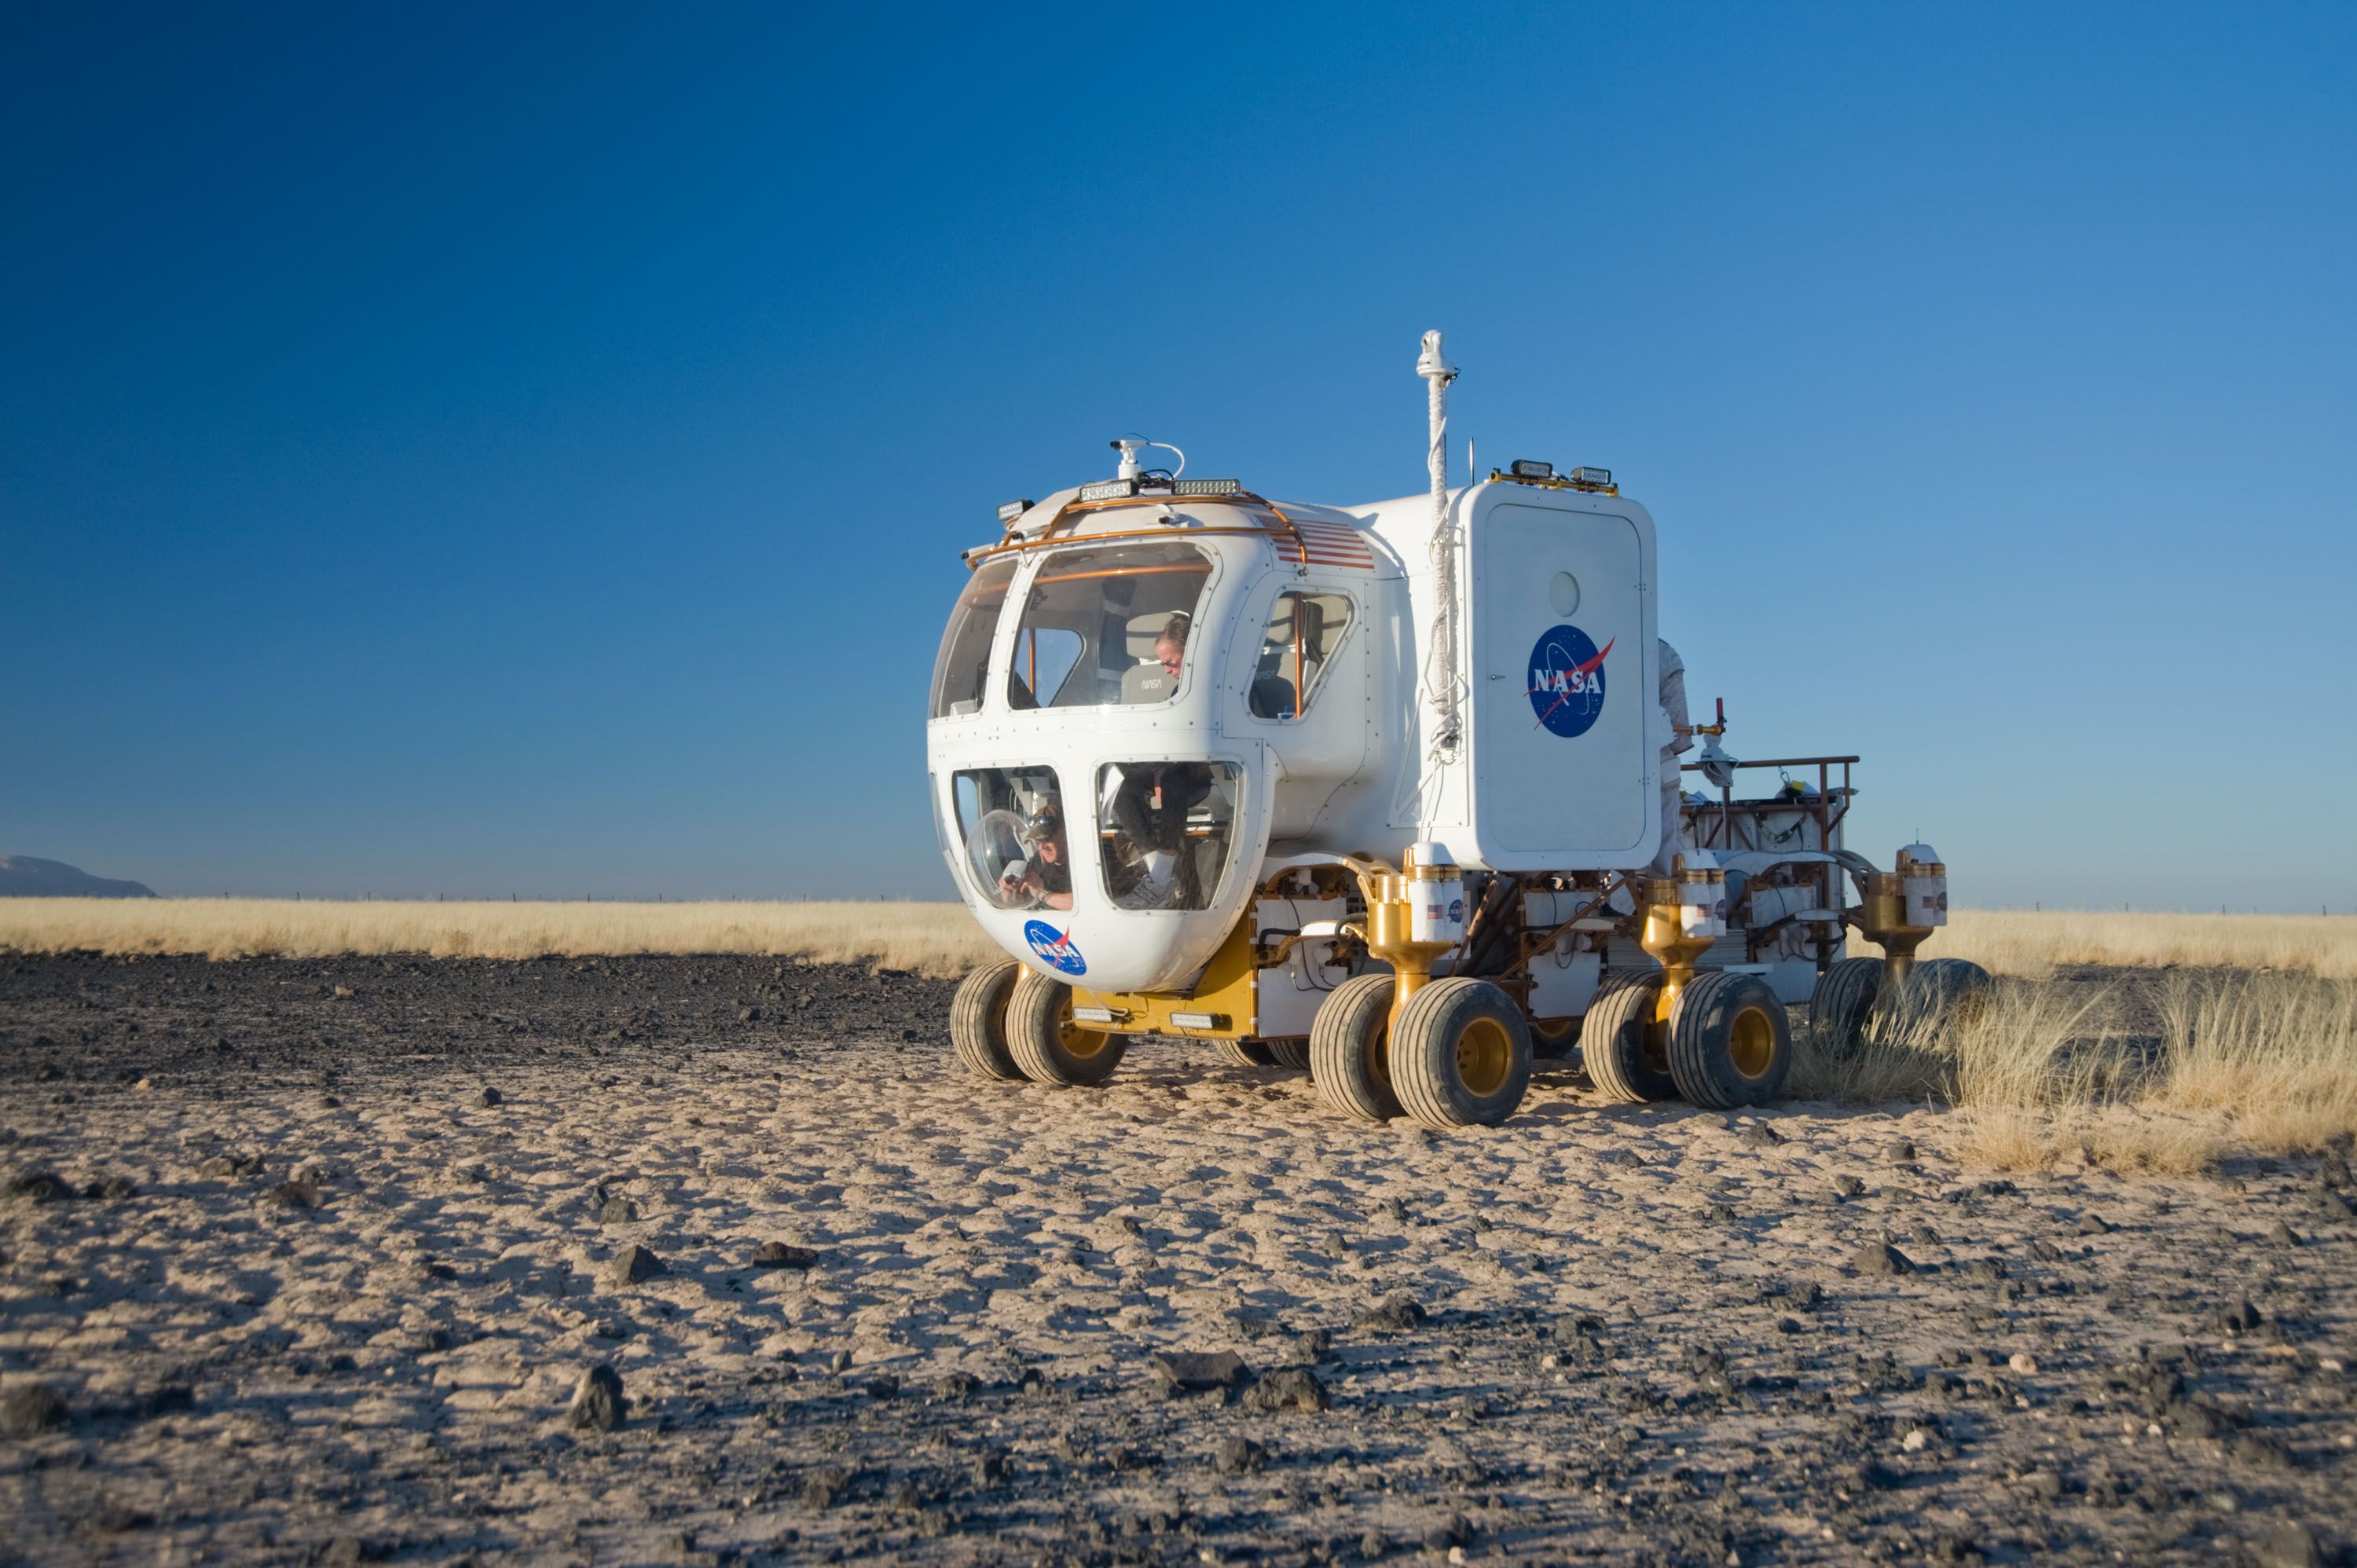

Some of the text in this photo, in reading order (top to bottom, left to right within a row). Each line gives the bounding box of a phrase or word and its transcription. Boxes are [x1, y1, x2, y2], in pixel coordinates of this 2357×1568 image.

[1142, 679, 1162, 690] NASA
[1534, 669, 1602, 694] NASA
[1031, 942, 1080, 958] NASA
